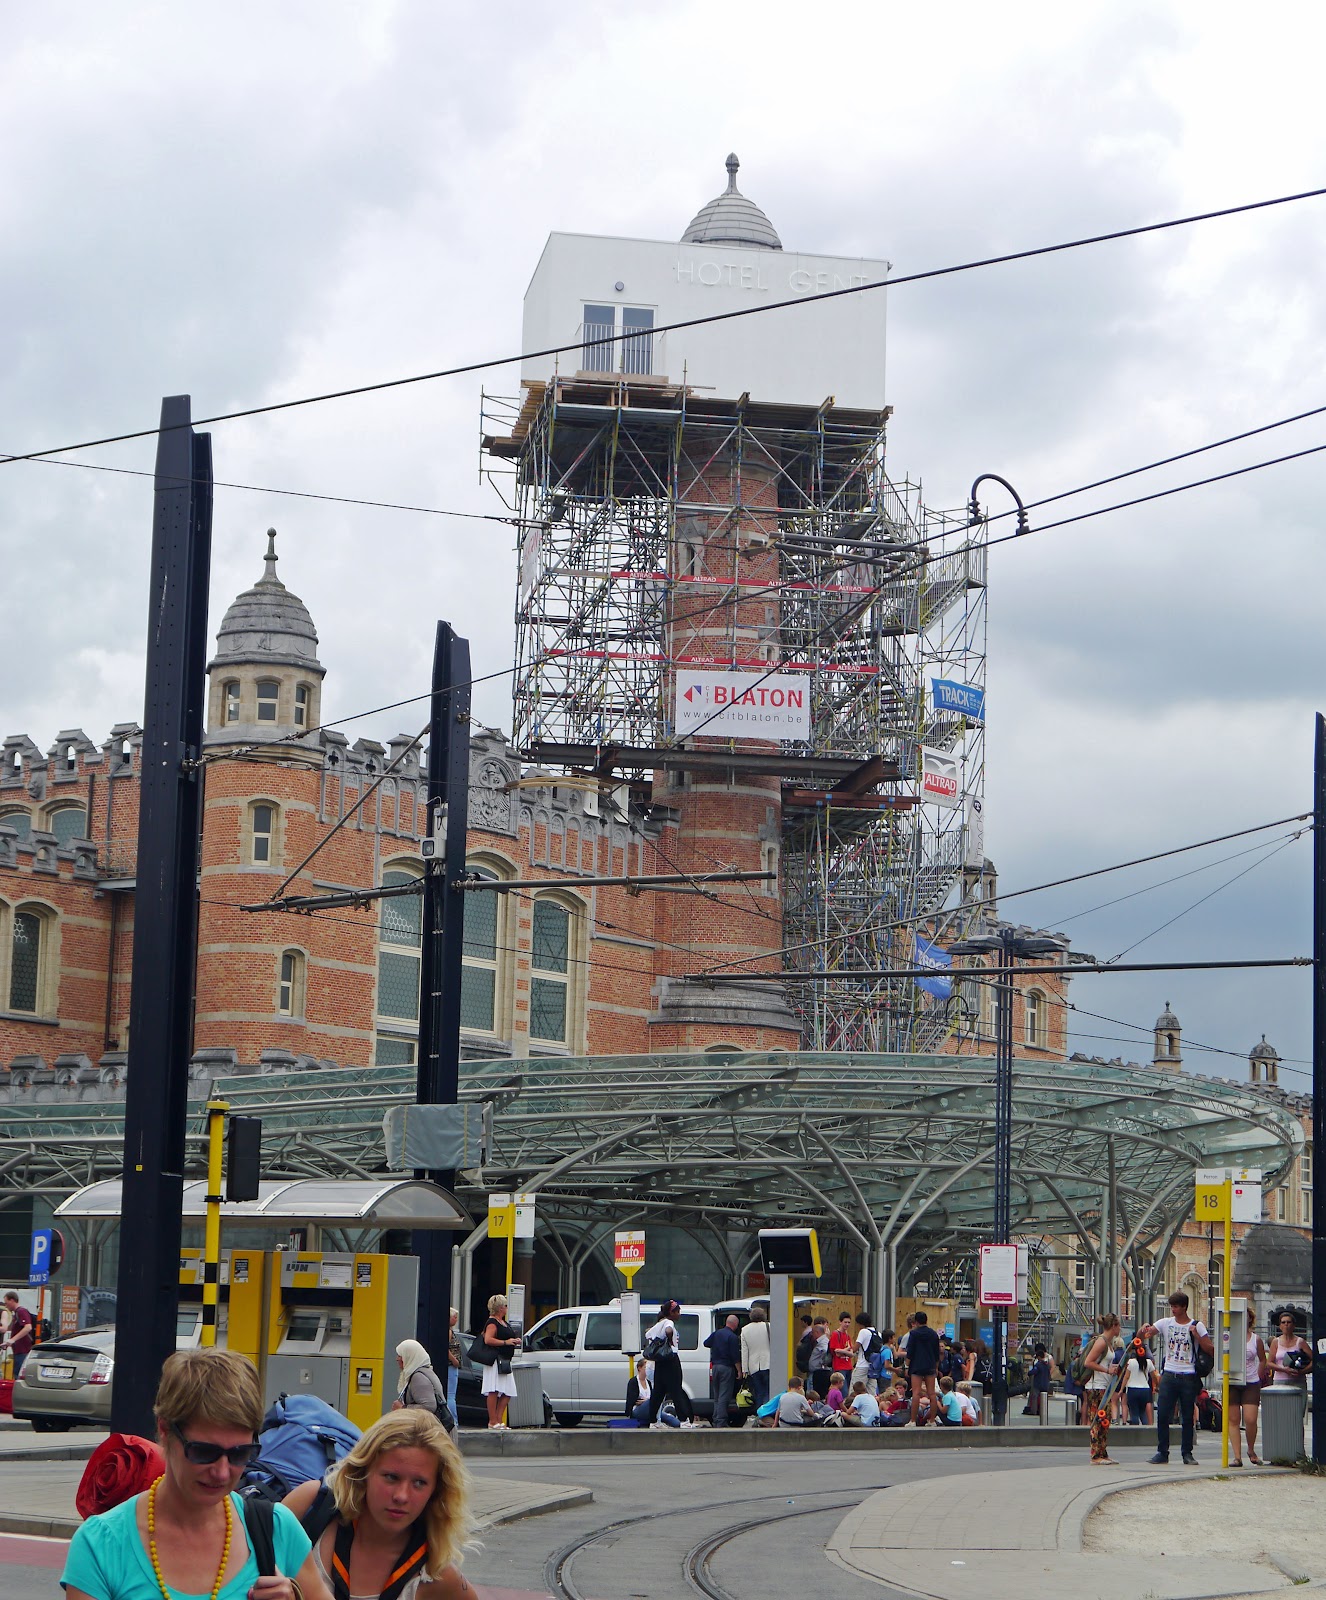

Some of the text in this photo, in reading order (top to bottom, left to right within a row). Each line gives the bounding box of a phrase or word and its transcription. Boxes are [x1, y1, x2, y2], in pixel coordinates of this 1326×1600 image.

[677, 261, 868, 297] HOTEL GENT
[692, 575, 717, 583] ALTRAD
[626, 652, 651, 660] ALTRAD
[836, 664, 861, 672] ALTRAD
[714, 685, 803, 708] BLATON
[939, 685, 970, 708] TRACK
[925, 773, 957, 791] ALTRAD
[1202, 1194, 1218, 1208] 18
[493, 1215, 505, 1227] 17
[32, 1235, 48, 1266] P
[620, 1244, 640, 1258] Info
[62, 1295, 78, 1303] GENT
[61, 1311, 77, 1322] 100
[61, 1322, 77, 1331] JAAR
